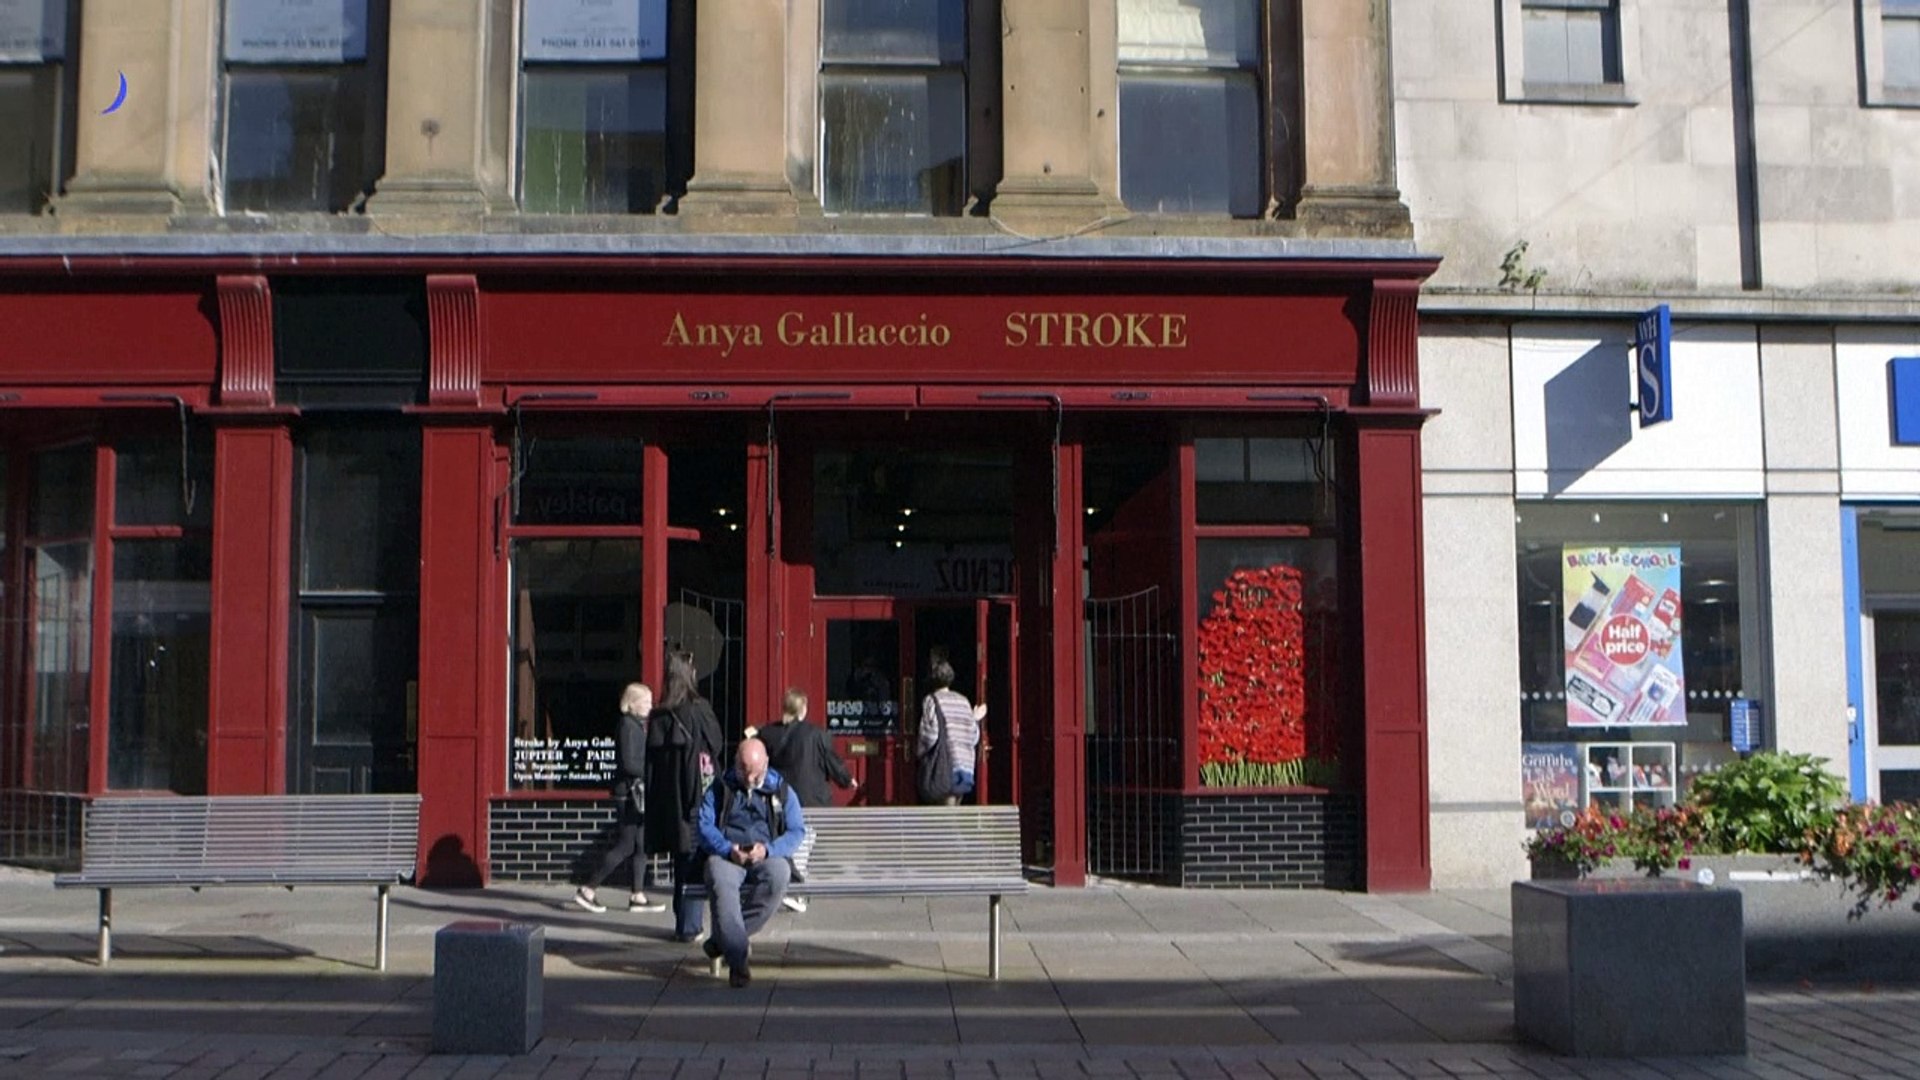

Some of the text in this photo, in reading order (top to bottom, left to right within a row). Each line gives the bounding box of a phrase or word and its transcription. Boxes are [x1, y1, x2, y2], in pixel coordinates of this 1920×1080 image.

[663, 312, 1187, 357] Anya Gallaccio STROKE
[1639, 315, 1657, 339] WH
[1640, 341, 1659, 419] S
[1567, 552, 1607, 567] BACK
[1622, 553, 1677, 569] SCHOOL
[1608, 624, 1642, 639] Half
[1605, 640, 1645, 655] price
[514, 737, 616, 749] Stroke by Anya Galla
[514, 750, 564, 761] JUPITER
[587, 750, 616, 761] PAIS
[513, 773, 533, 782] Open
